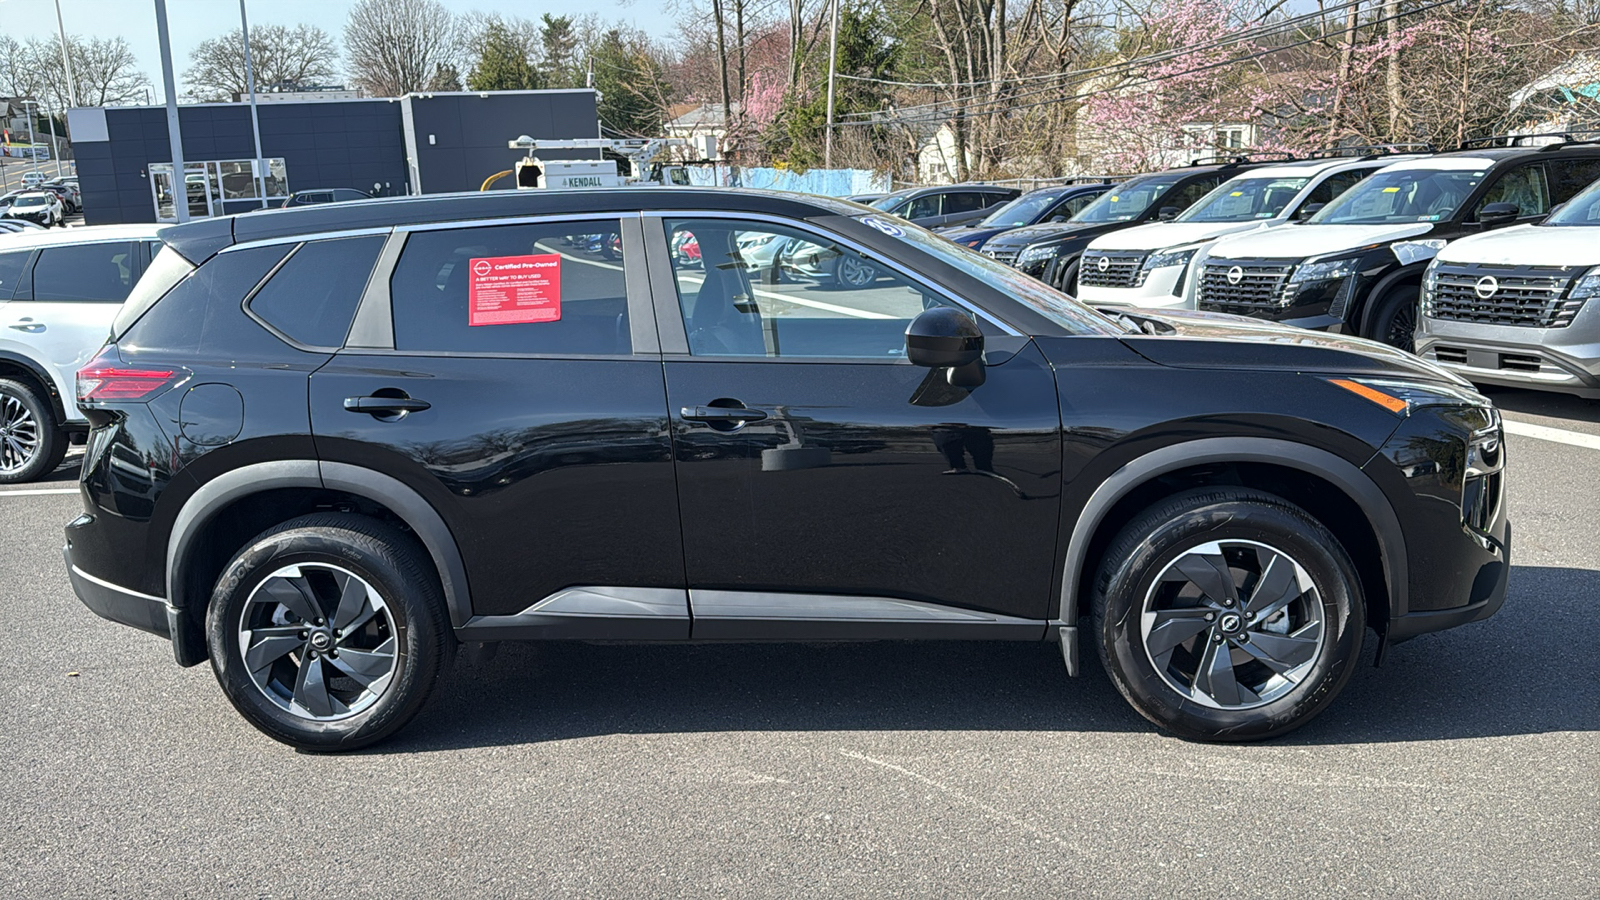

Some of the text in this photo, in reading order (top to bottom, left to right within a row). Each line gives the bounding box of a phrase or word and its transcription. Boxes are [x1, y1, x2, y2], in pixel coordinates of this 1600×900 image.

[568, 176, 602, 188] KENDALL
[494, 262, 521, 270] Certified
[522, 261, 557, 269] Pre-Owned
